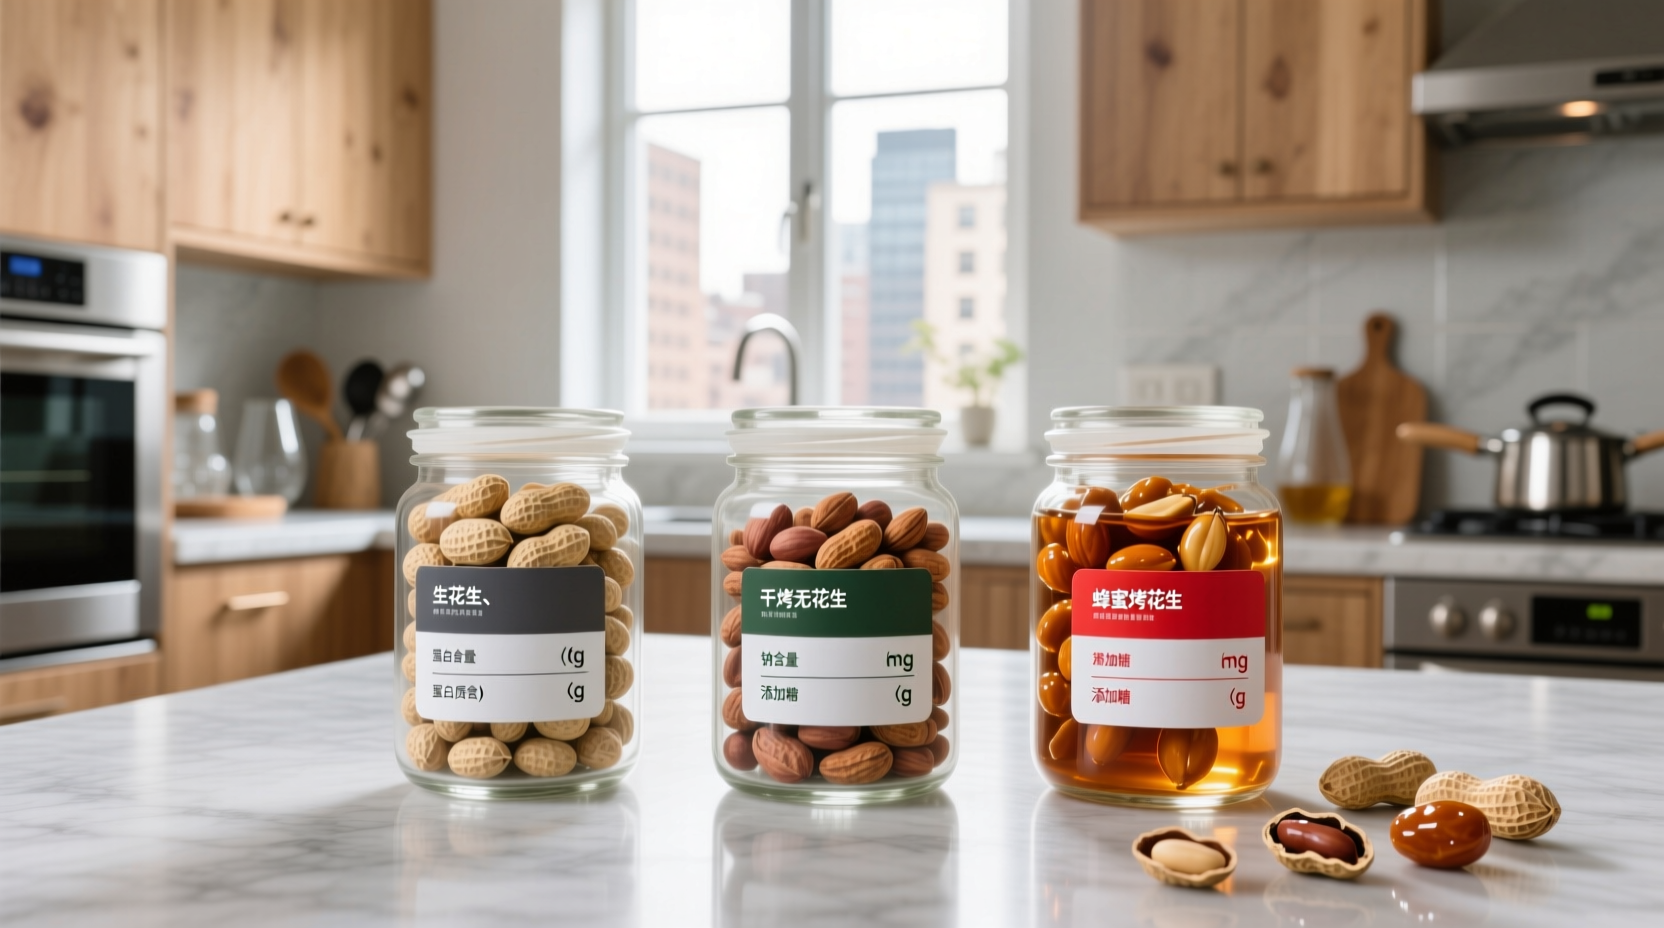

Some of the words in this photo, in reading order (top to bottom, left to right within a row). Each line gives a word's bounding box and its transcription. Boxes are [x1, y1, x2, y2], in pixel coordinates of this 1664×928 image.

[759, 587, 848, 609] 干烤无花生
[1091, 587, 1183, 611] 蜂蜜烤花生
